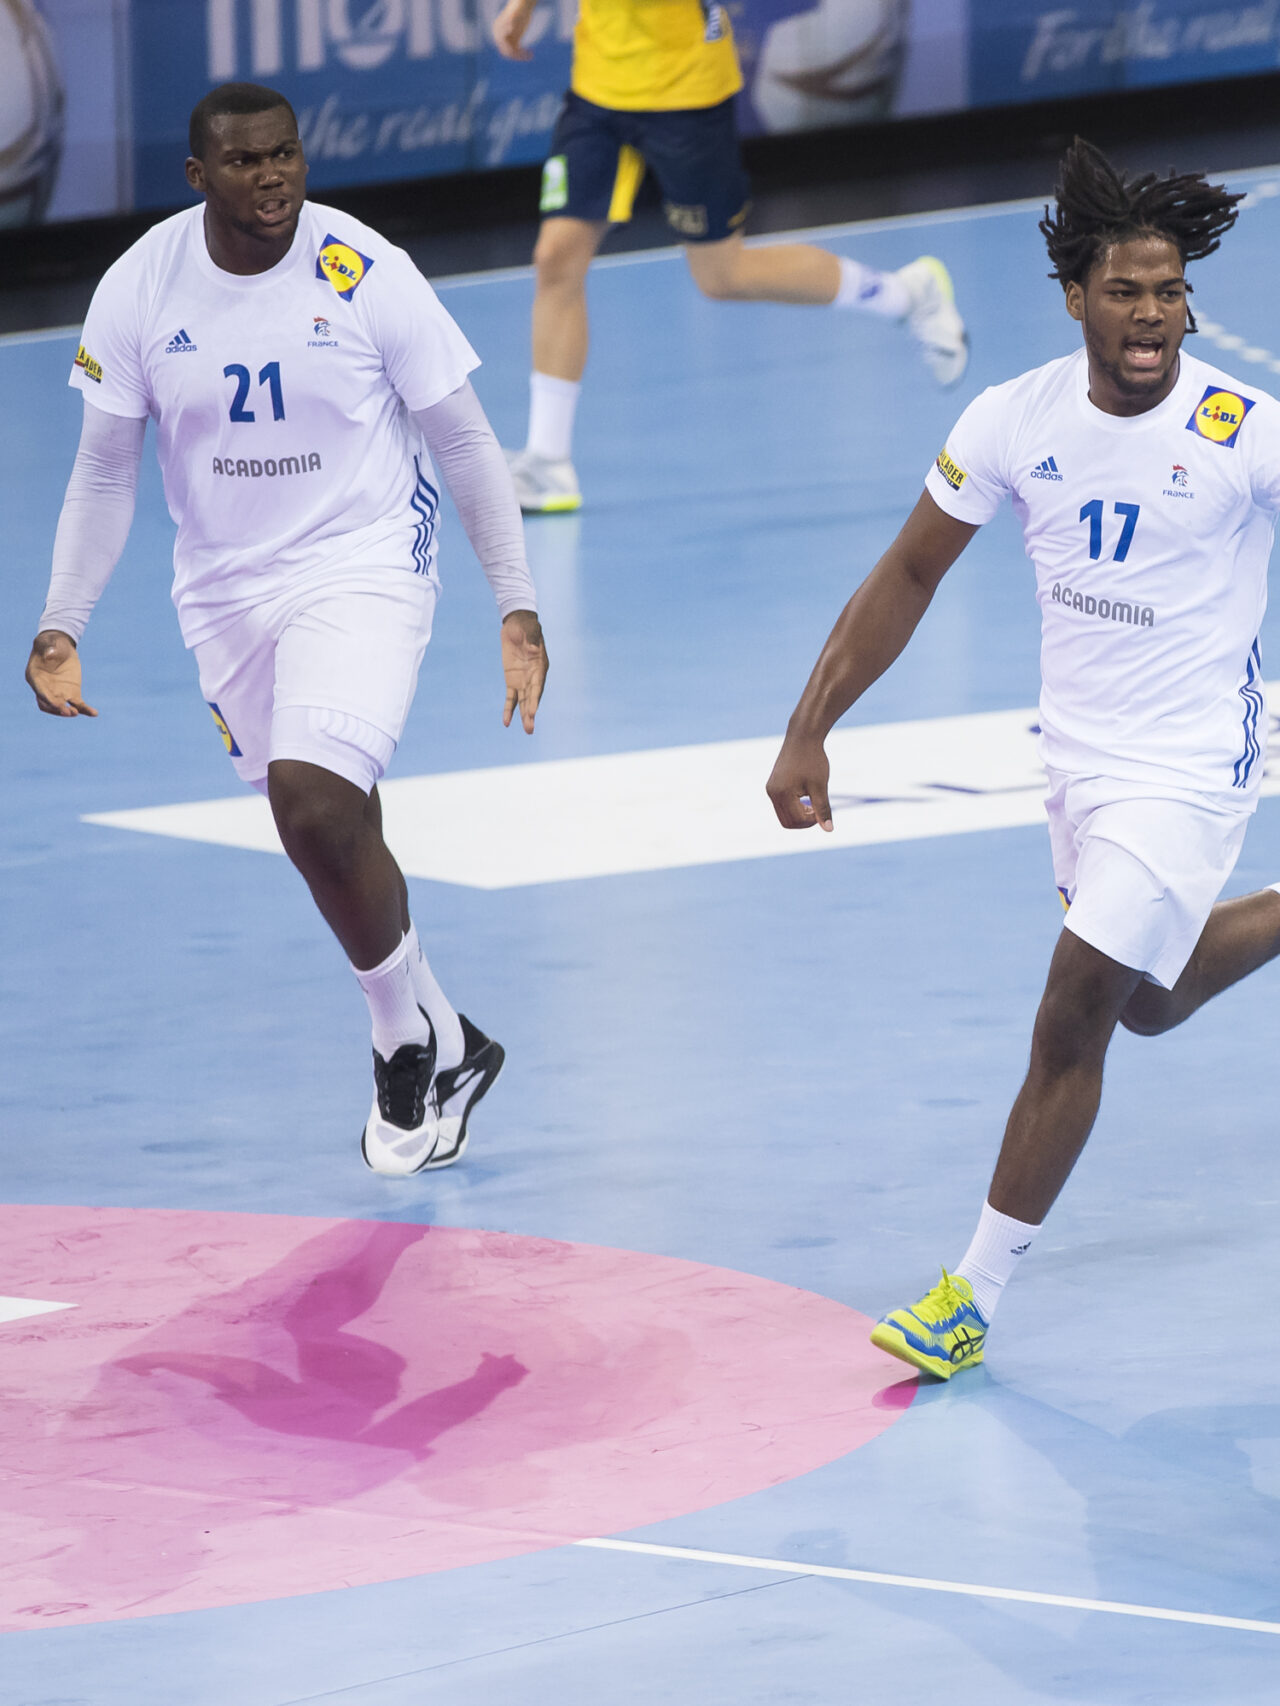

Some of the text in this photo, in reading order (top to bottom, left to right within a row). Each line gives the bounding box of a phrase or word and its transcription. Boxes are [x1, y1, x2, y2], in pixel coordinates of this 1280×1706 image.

[1021, 9, 1098, 81] For
[1102, 0, 1179, 64] the
[375, 79, 488, 152] real
[486, 94, 566, 166] ga
[165, 344, 198, 354] adidas
[223, 361, 285, 423] 21
[213, 452, 322, 478] ACADOMIA
[1030, 470, 1064, 482] adidas
[1079, 499, 1141, 563] 17
[1052, 582, 1155, 627] ACADOMIA
